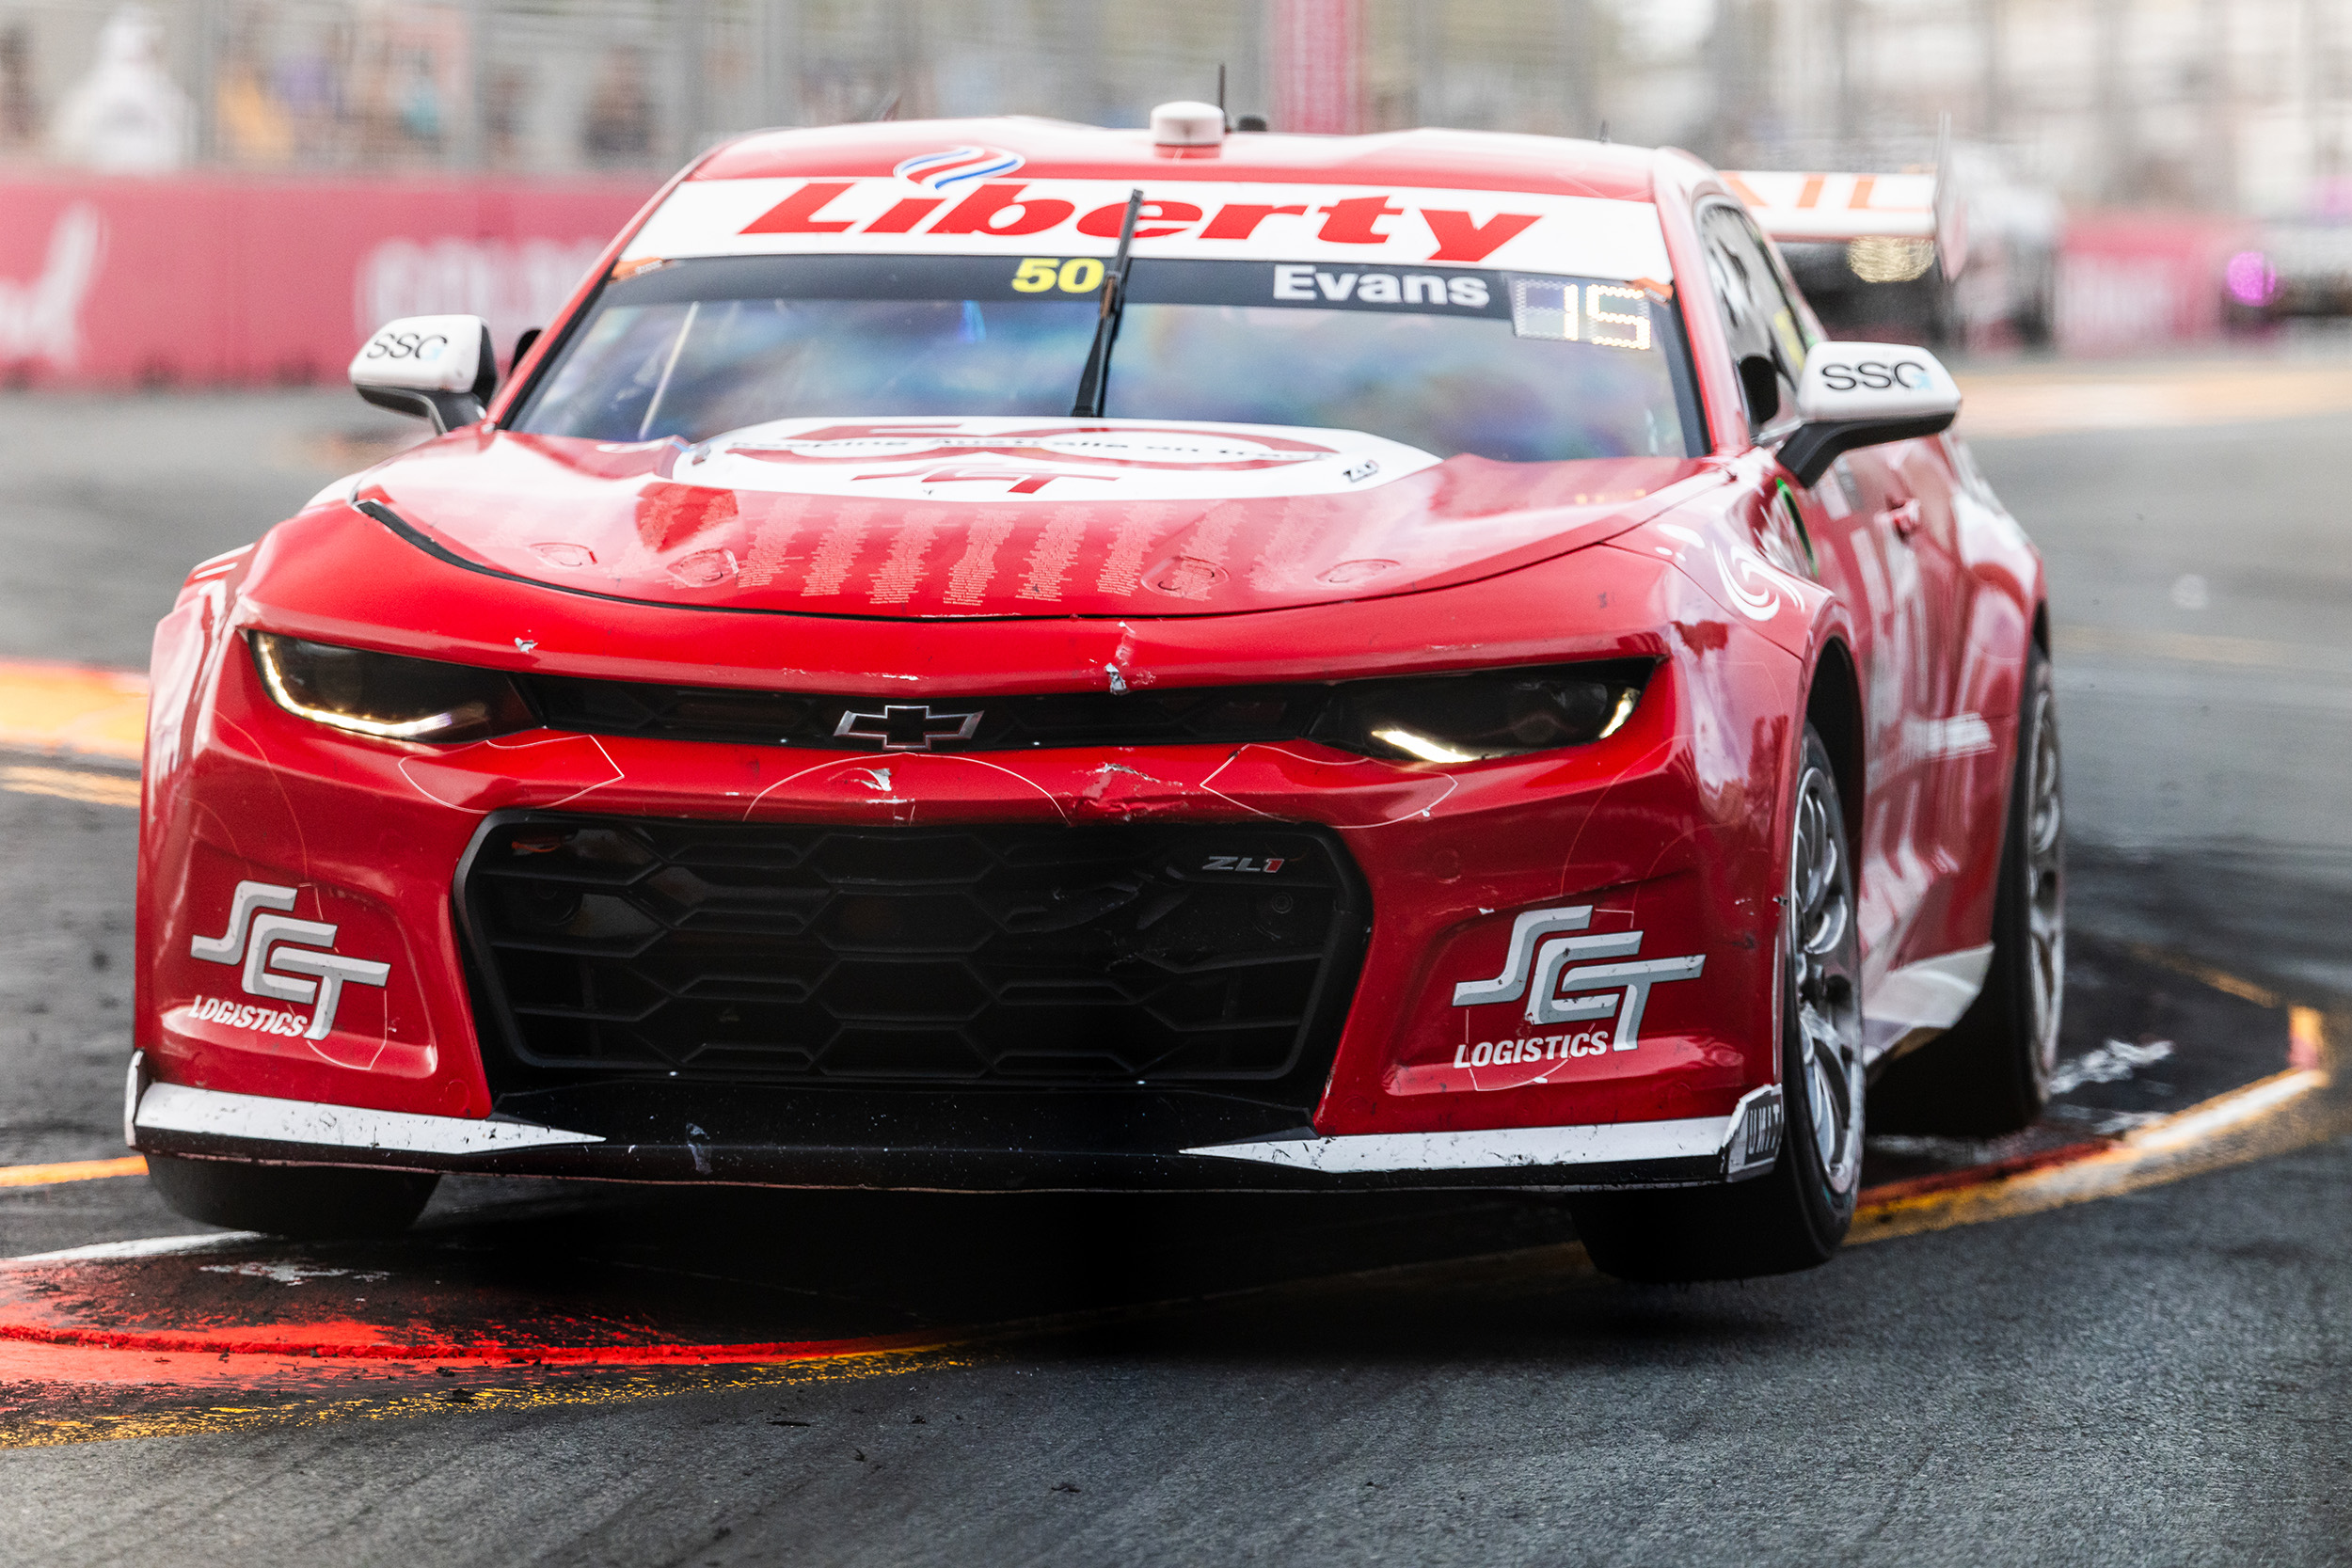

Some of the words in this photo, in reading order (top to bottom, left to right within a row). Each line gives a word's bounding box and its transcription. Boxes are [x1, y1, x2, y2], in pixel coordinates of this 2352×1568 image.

[737, 182, 1544, 262] Liberty
[1010, 257, 1105, 293] 50
[1273, 264, 1490, 309] Evans
[1201, 856, 1285, 874] ZL1
[190, 879, 391, 1040] SCT
[1452, 904, 1707, 1053] SCT
[188, 995, 309, 1037] LOGISTICS
[1453, 1031, 1609, 1069] LOGISTICS
